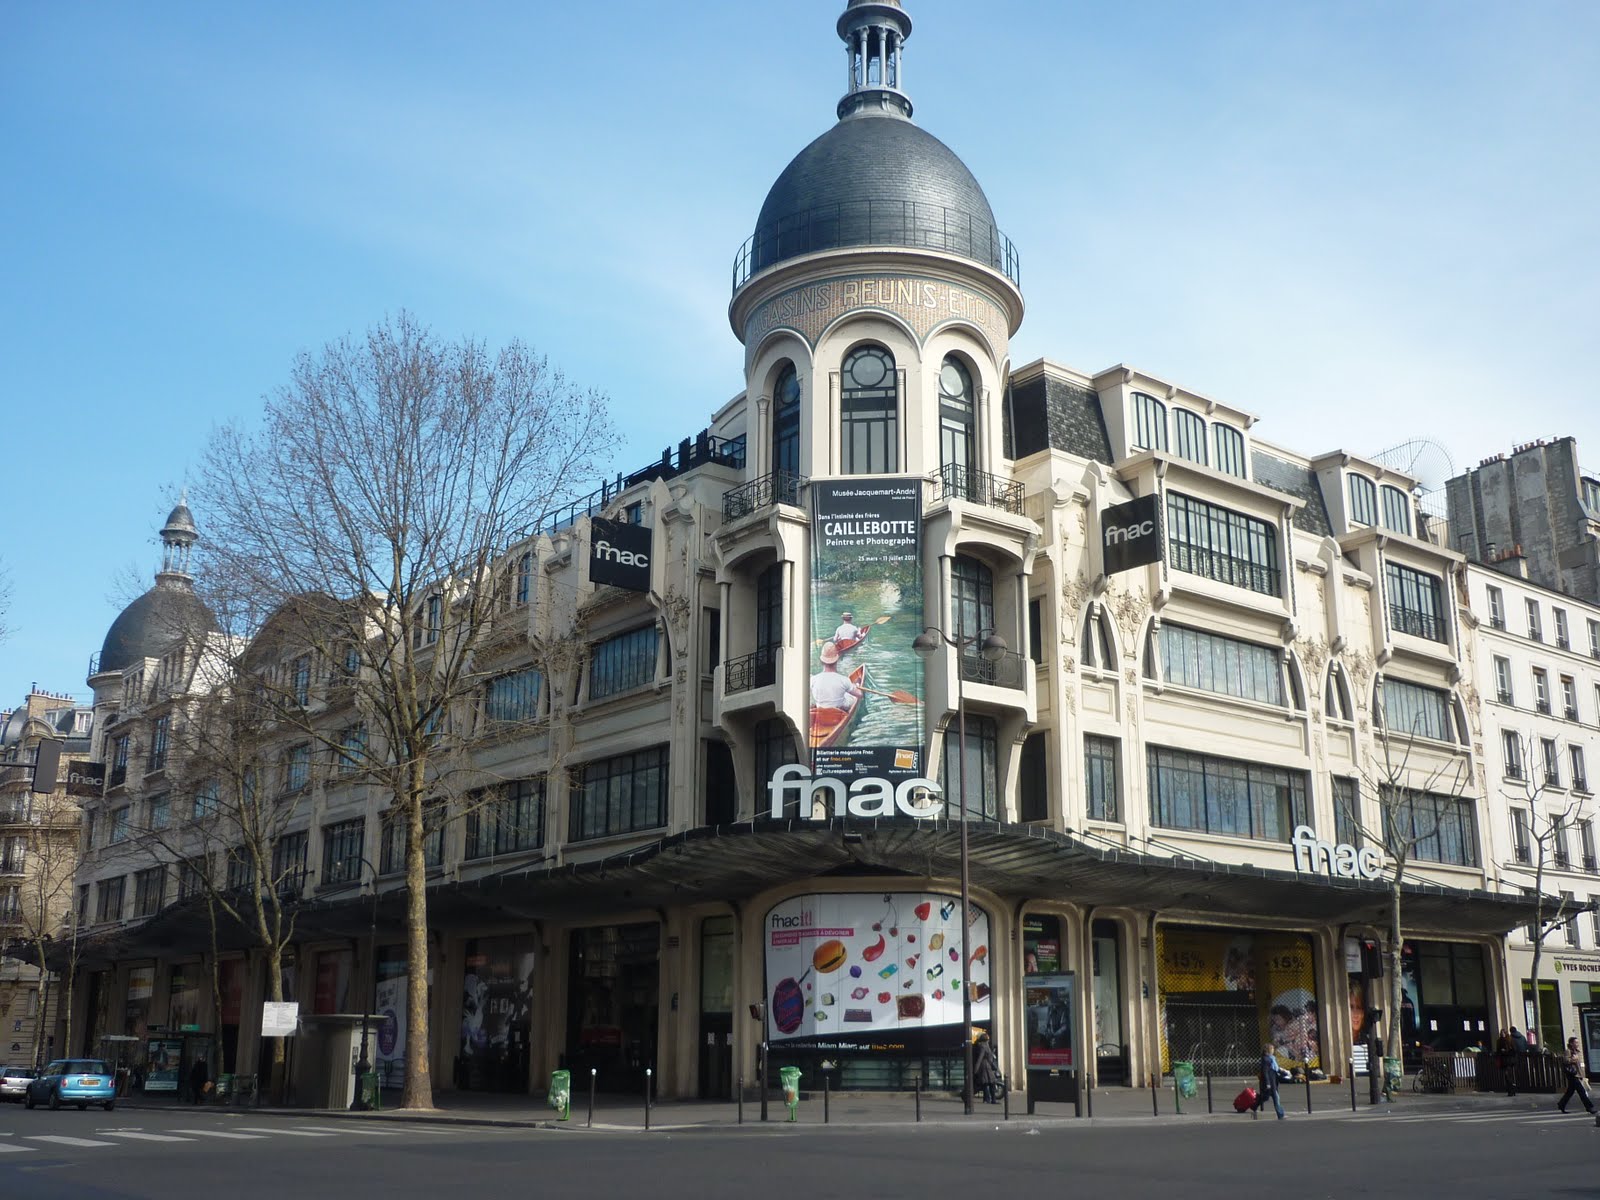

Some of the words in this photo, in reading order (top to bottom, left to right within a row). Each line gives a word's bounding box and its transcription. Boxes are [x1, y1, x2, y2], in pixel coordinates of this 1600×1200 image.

[832, 489, 854, 497] Musée
[854, 488, 916, 497] Jacquemart-André
[825, 520, 915, 536] CAILLEBOTTE
[1105, 520, 1153, 546] fnac
[826, 538, 854, 546] Peintre
[856, 538, 864, 546] et
[866, 537, 916, 546] Photographe
[595, 540, 648, 568] fnac
[69, 772, 103, 786] fnac
[767, 763, 944, 819] fnac
[1292, 825, 1382, 879] fnac
[1562, 963, 1578, 971] YVES
